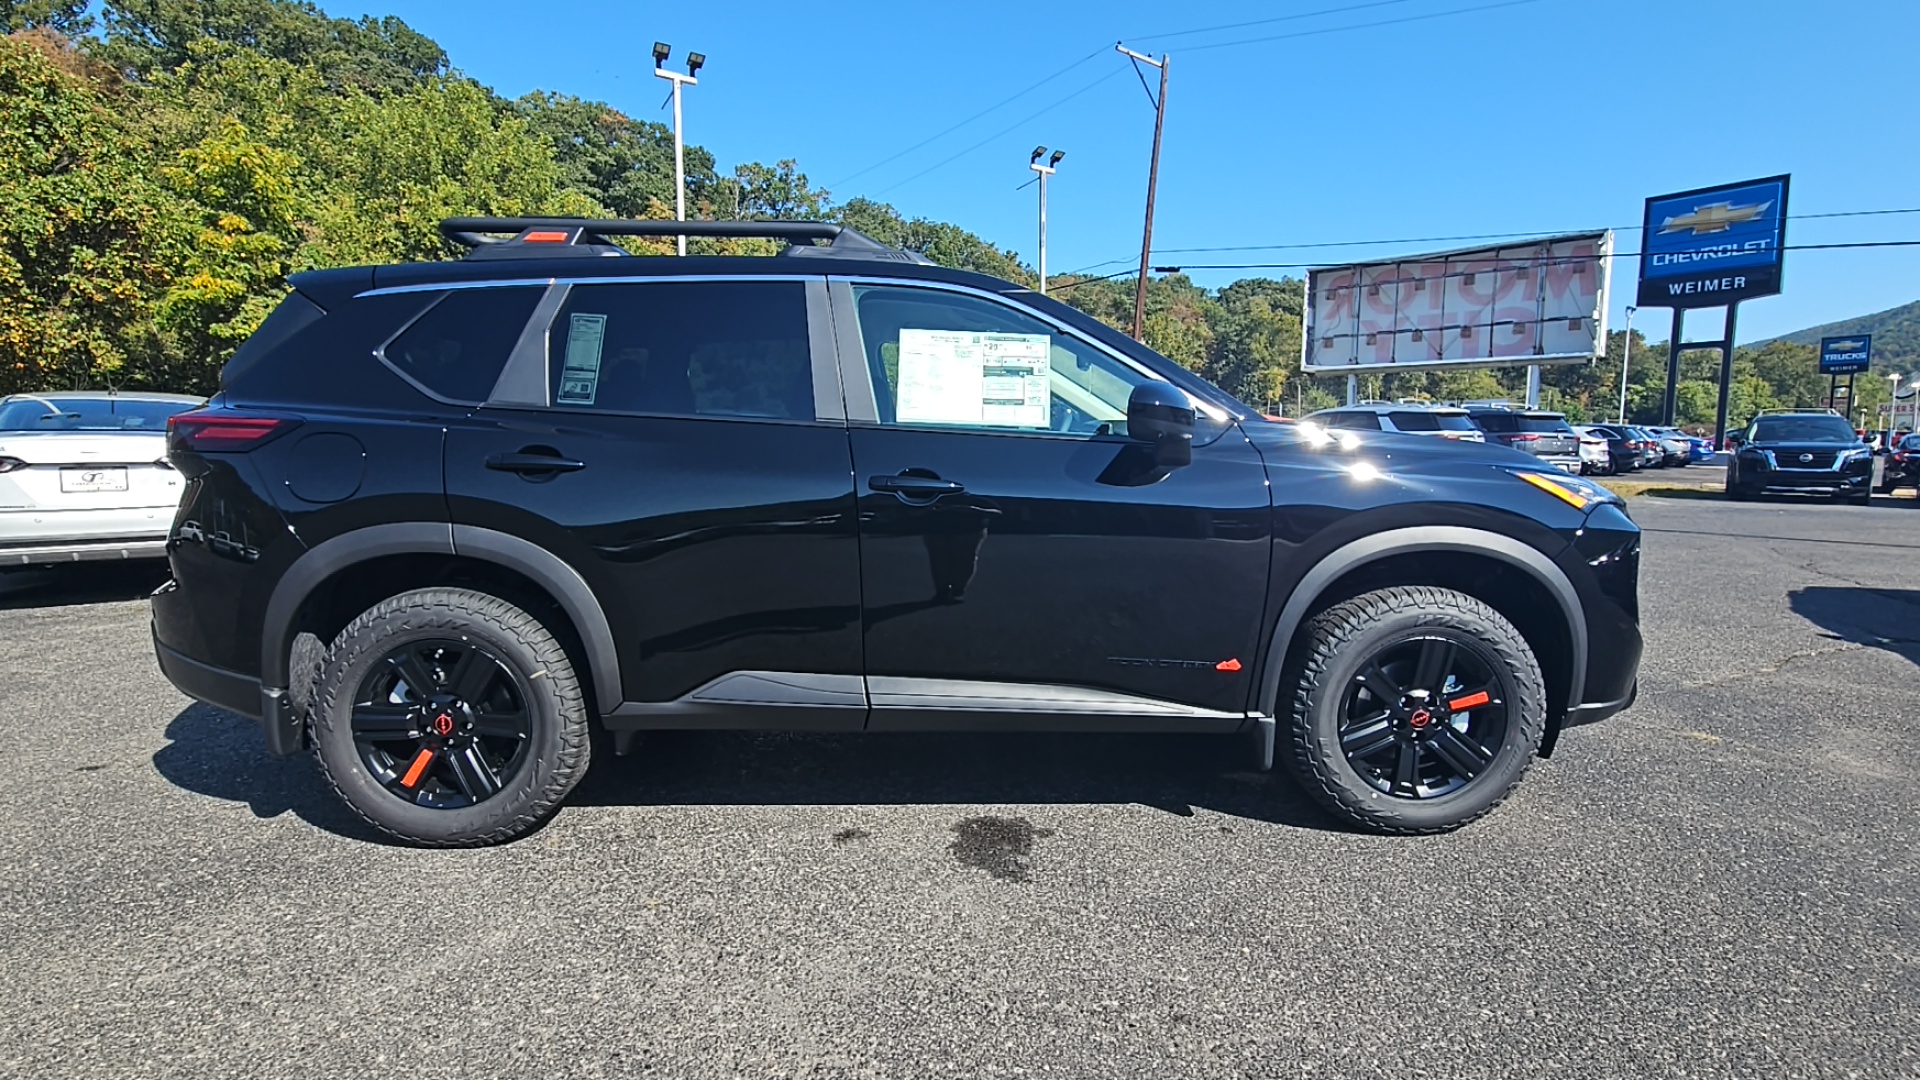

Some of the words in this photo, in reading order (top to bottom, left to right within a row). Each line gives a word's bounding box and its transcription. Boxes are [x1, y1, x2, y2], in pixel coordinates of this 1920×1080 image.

[1652, 238, 1771, 266] CHEVROLET
[1668, 276, 1746, 295] WEIMER
[1824, 351, 1867, 361] TRUCKS
